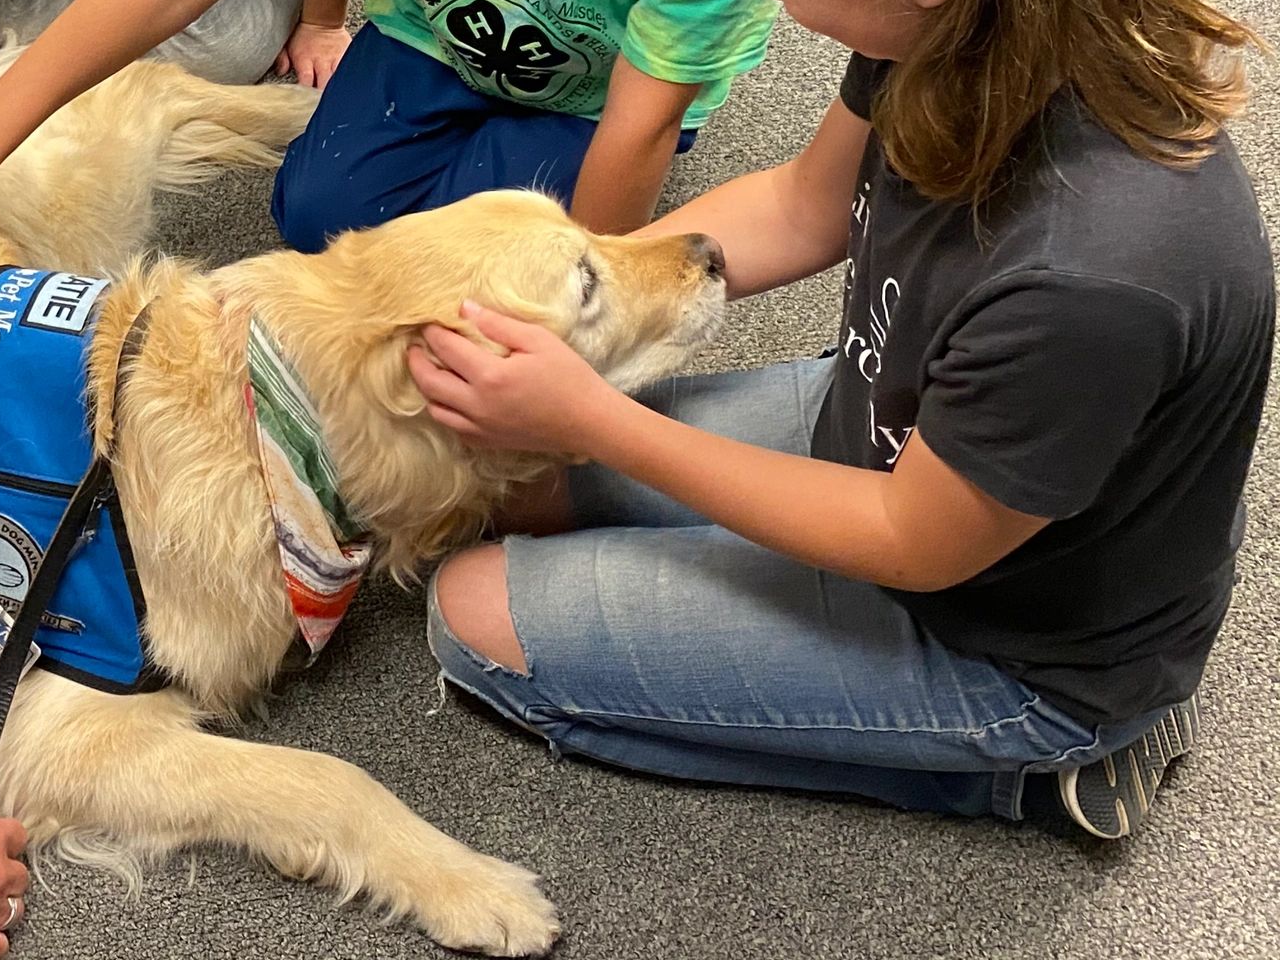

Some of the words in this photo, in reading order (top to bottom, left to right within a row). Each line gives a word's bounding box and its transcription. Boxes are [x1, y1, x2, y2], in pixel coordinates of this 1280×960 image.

[464, 11, 493, 39] H
[519, 41, 551, 61] H
[43, 276, 94, 322] ATIE
[1, 524, 24, 547] DOG
